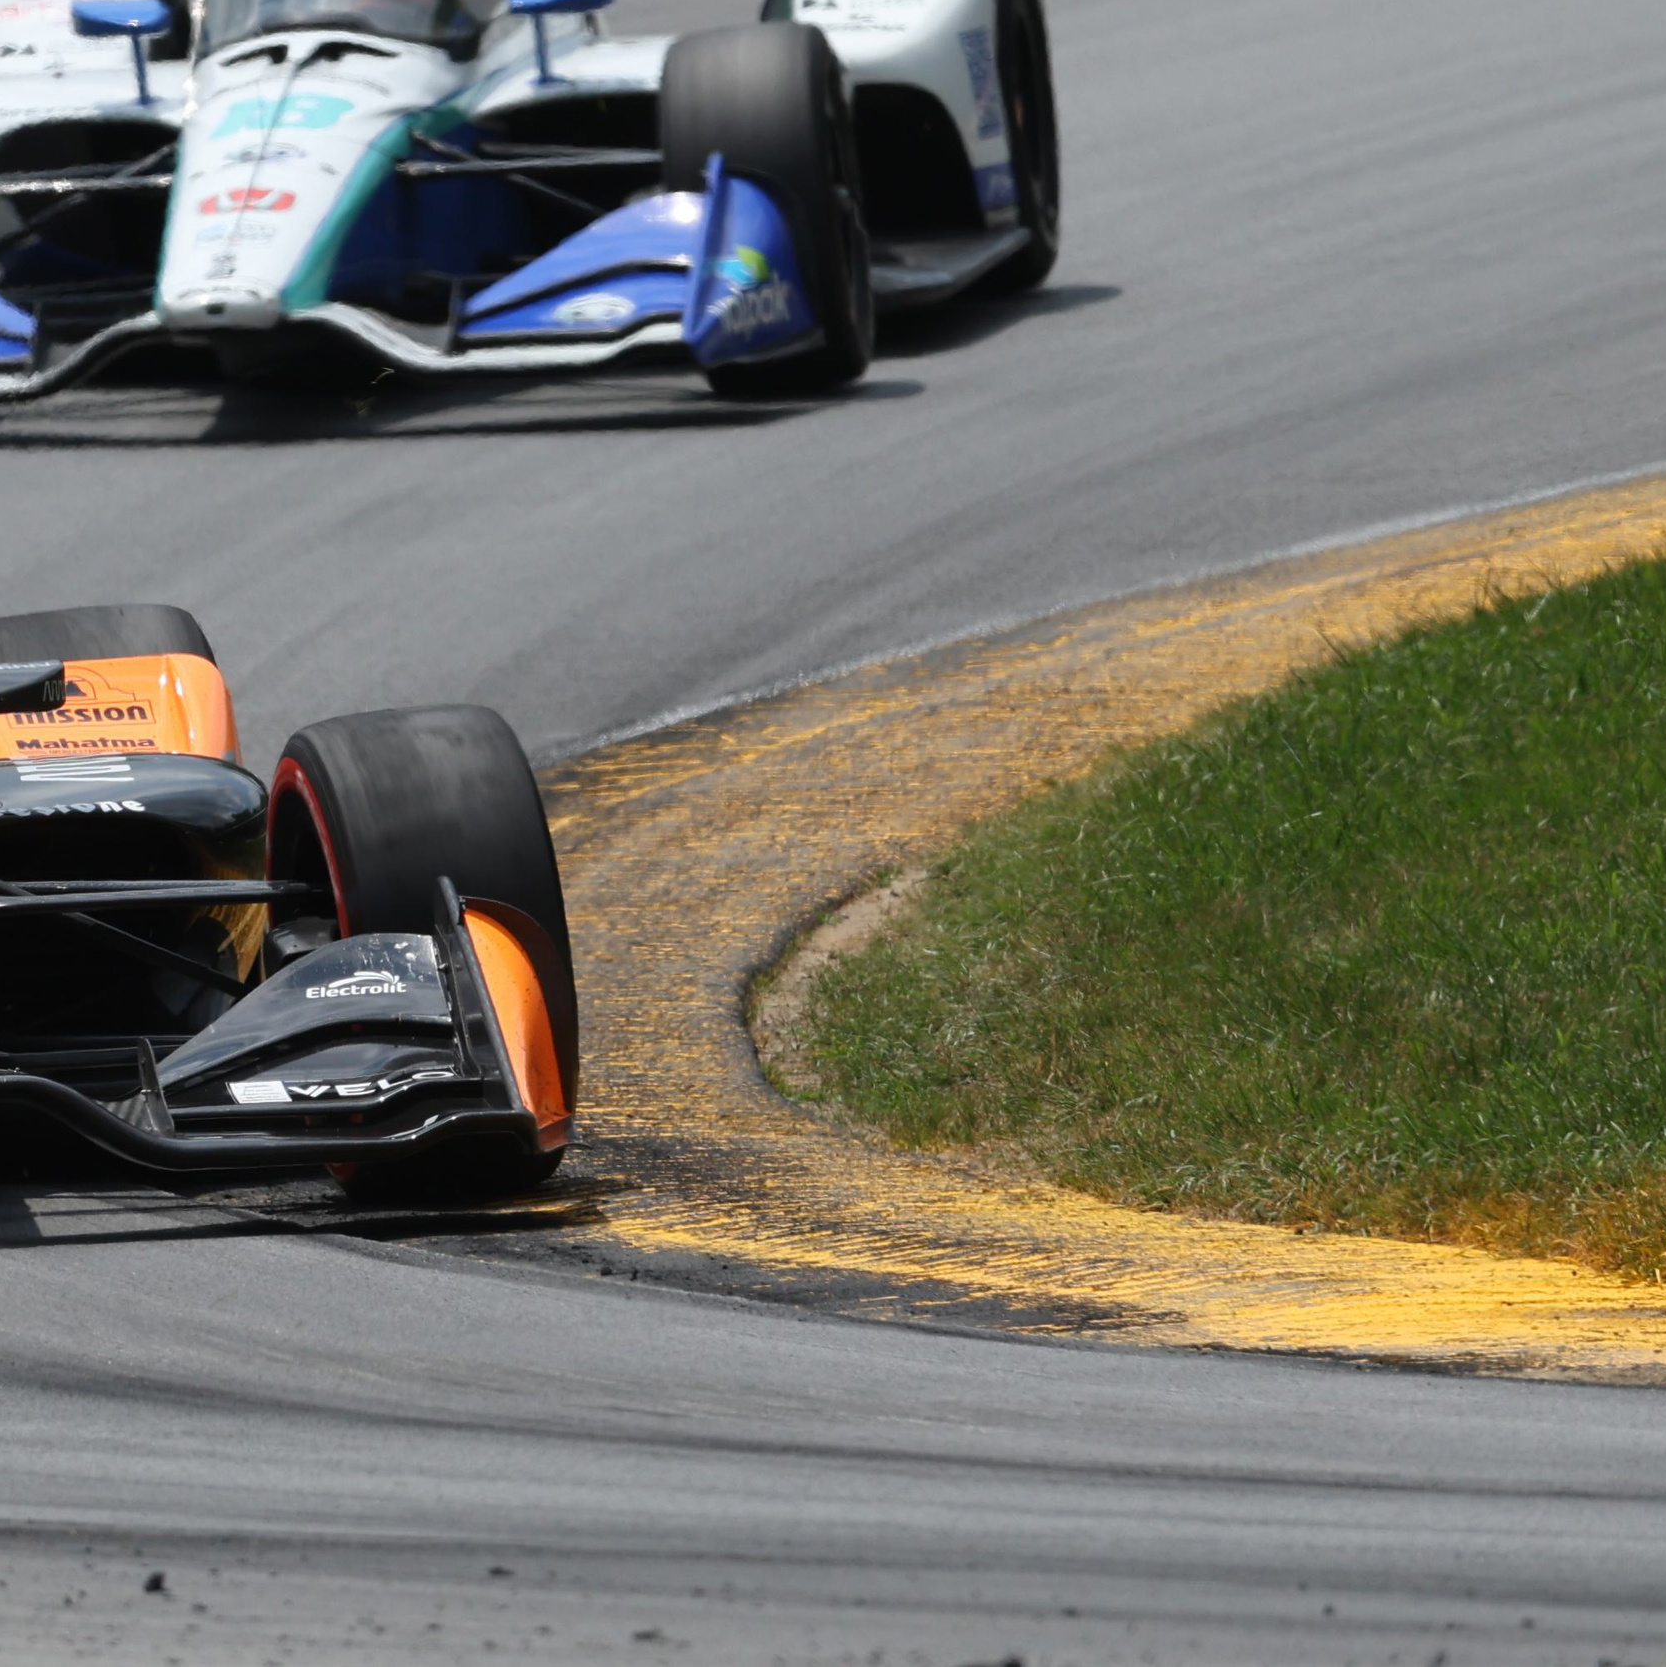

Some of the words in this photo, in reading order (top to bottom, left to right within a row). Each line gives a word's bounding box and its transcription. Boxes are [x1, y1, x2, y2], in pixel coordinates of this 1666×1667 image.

[209, 92, 356, 141] 18
[15, 737, 156, 750] Mahatma
[305, 982, 408, 999] Electrolit
[287, 1071, 455, 1098] VELO
